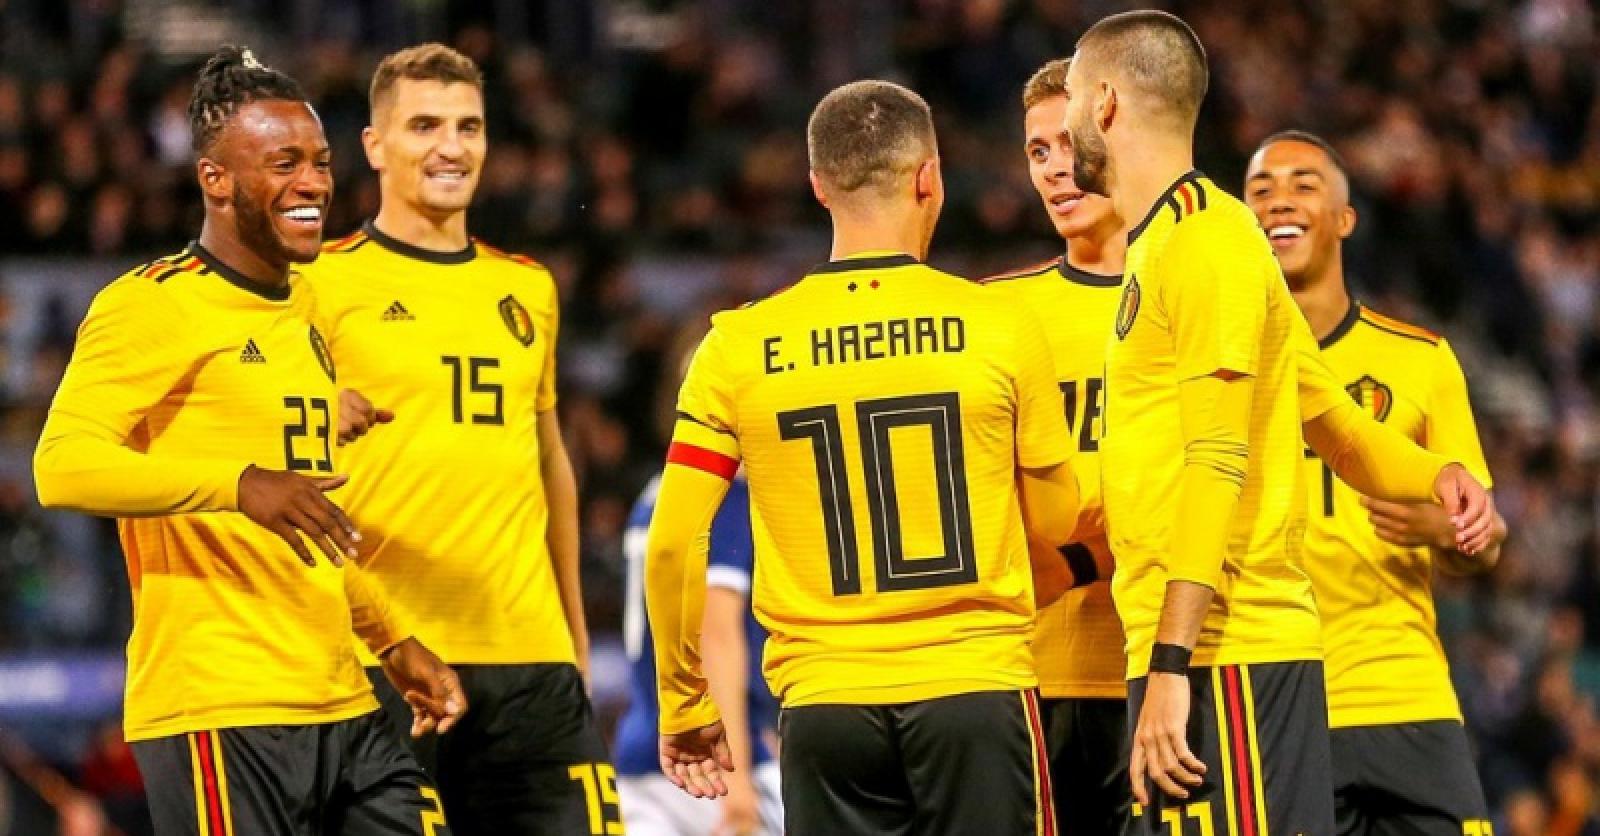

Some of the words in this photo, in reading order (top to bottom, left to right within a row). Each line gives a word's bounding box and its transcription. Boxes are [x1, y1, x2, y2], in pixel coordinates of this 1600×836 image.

[764, 336, 795, 374] E.
[811, 317, 965, 366] HAZARD
[441, 355, 504, 426] 15
[283, 396, 332, 472] 23
[776, 391, 978, 596] 10
[568, 764, 626, 835] 15
